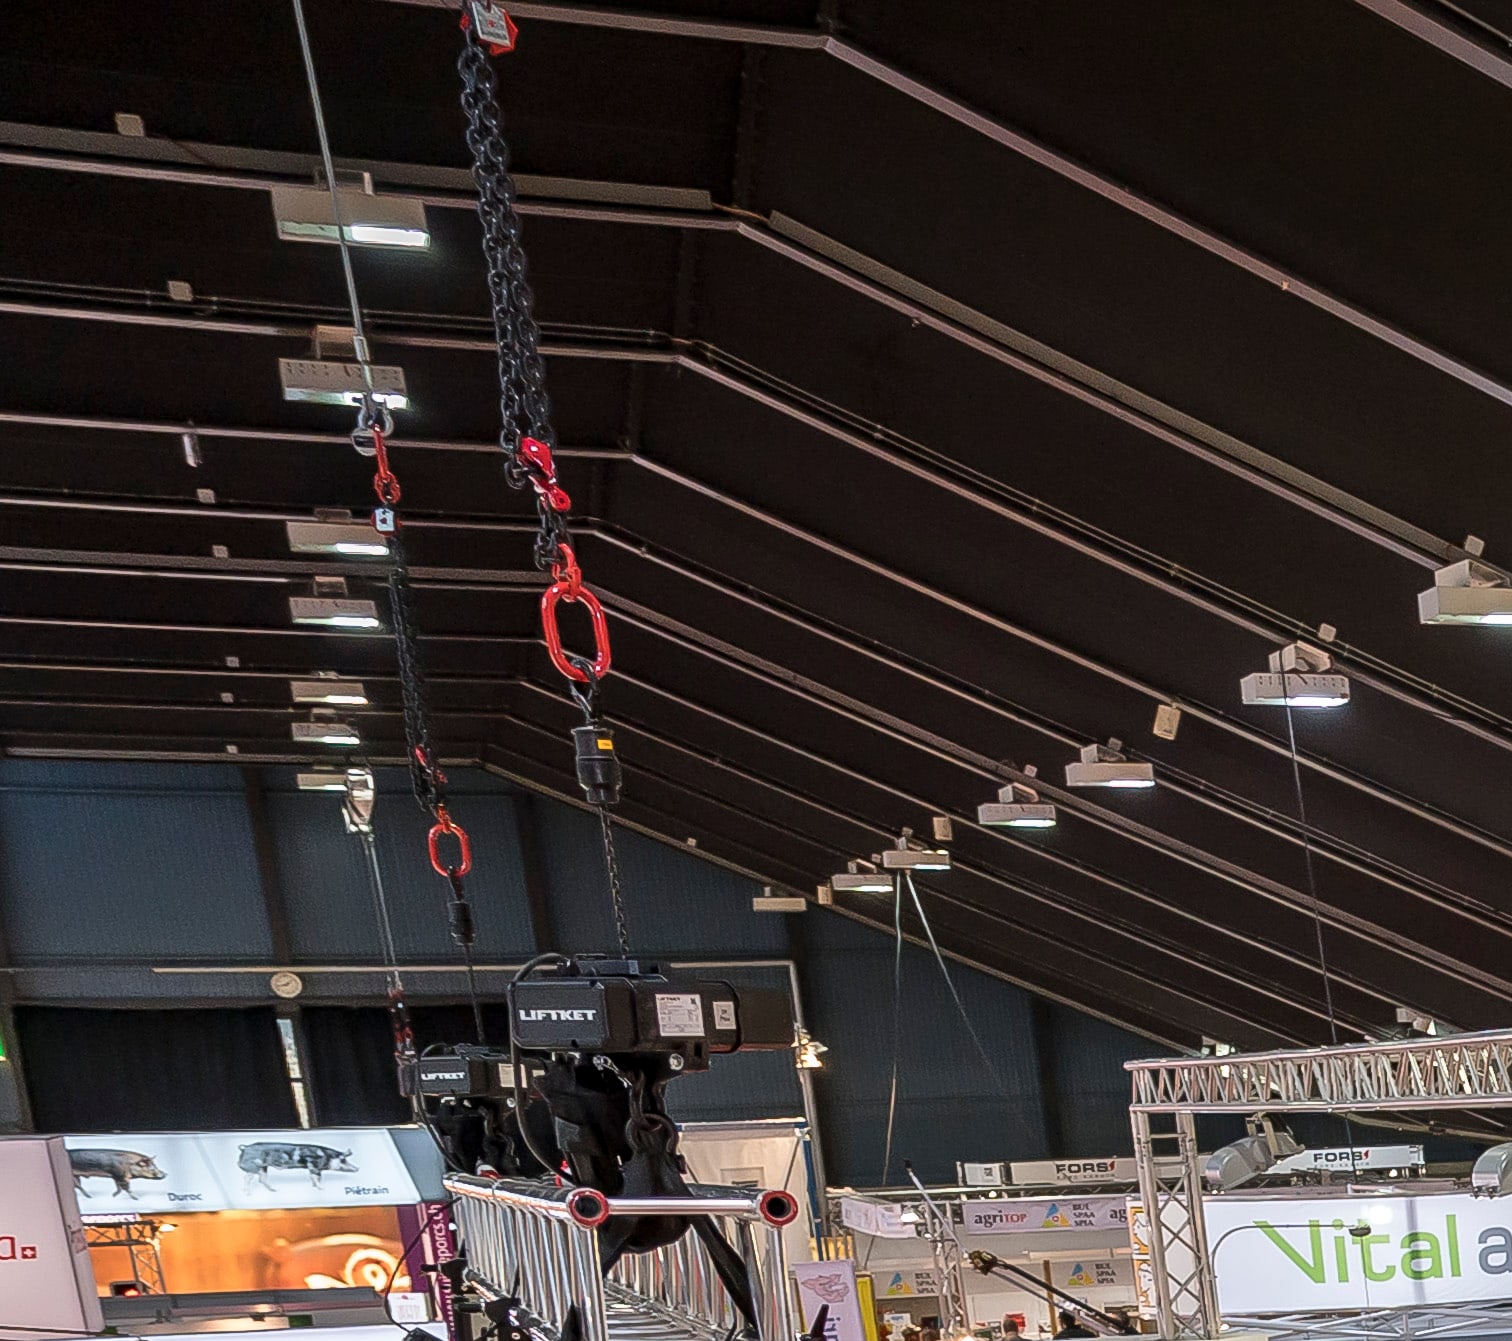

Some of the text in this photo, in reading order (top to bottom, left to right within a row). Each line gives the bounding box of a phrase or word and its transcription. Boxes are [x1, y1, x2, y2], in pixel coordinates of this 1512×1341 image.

[519, 1009, 597, 1022] LIFTKET
[421, 1071, 465, 1081] LIFTKET
[168, 1191, 203, 1202] Duroc
[344, 1184, 390, 1197] Piétrain
[1254, 1214, 1462, 1285] Vital
